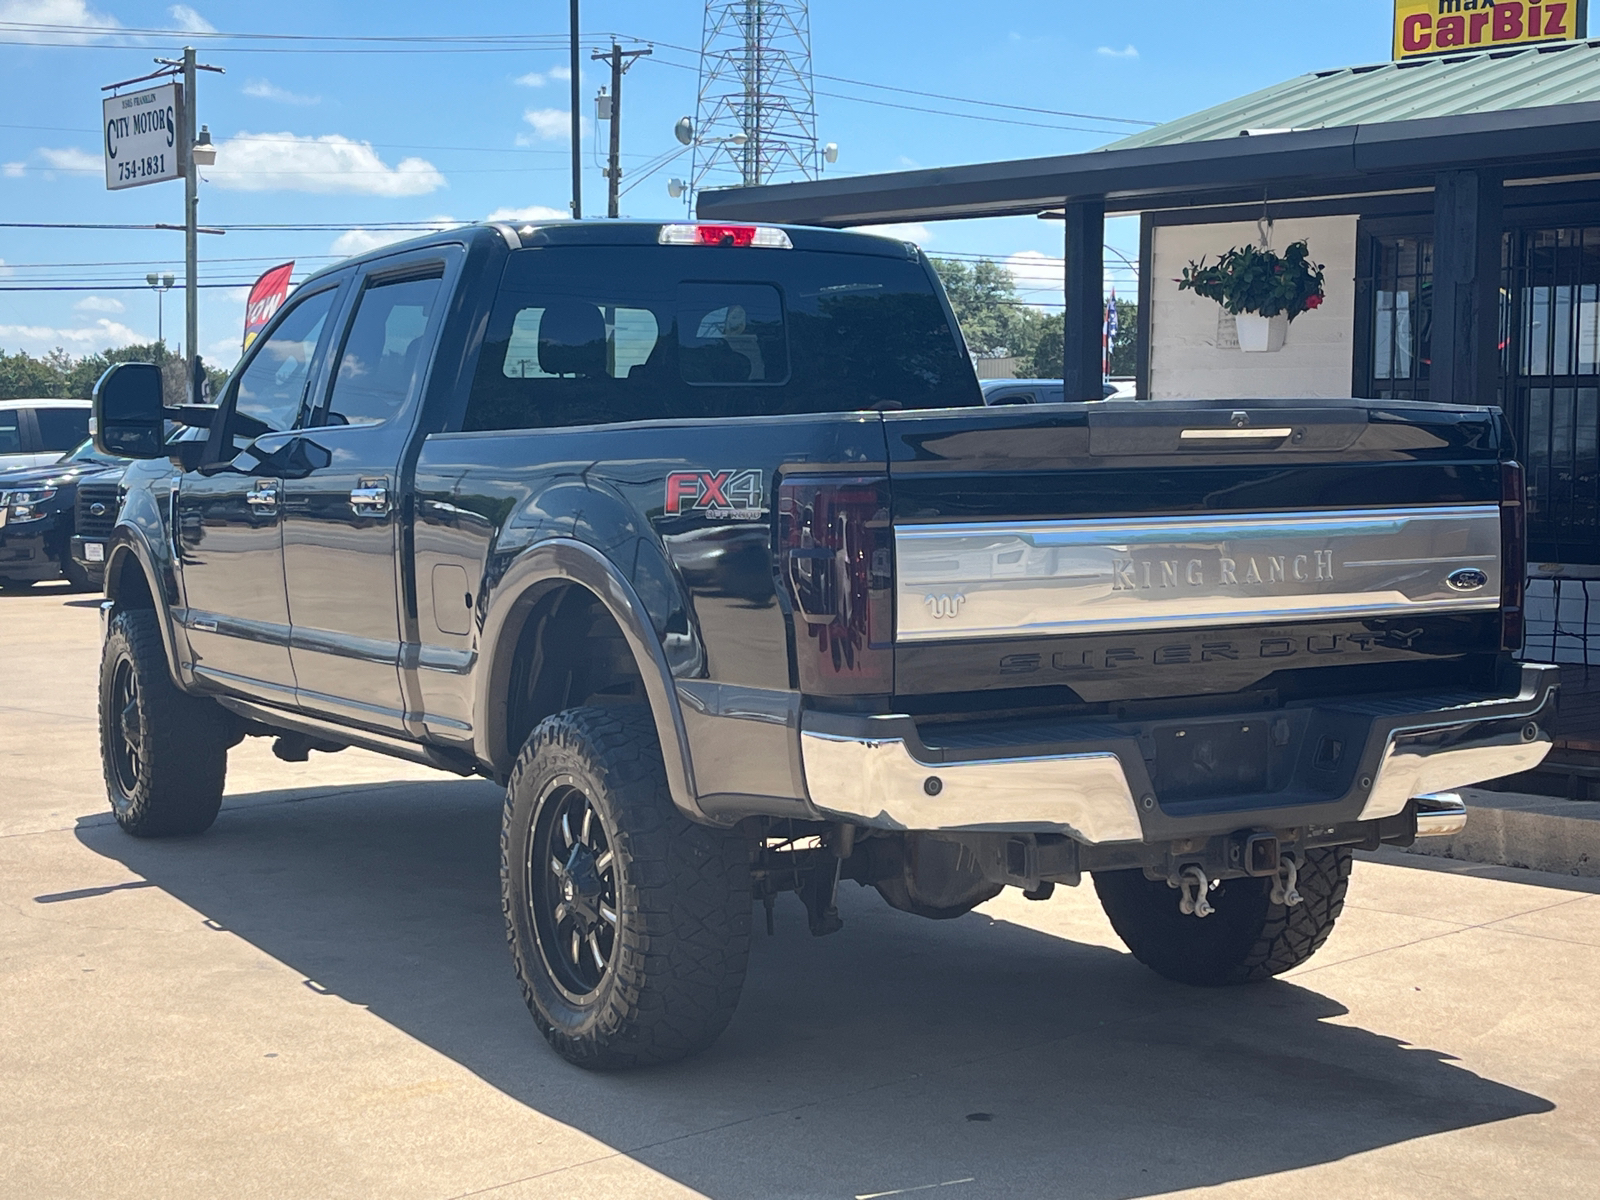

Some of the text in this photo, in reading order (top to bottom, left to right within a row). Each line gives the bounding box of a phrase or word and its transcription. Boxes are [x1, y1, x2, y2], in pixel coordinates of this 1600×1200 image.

[1402, 0, 1568, 52] CarBiz
[107, 105, 174, 159] CITY MOTORS
[664, 468, 763, 517] FX4
[1112, 550, 1334, 591] KING RANCH
[1000, 627, 1425, 675] SUPER DUTY
